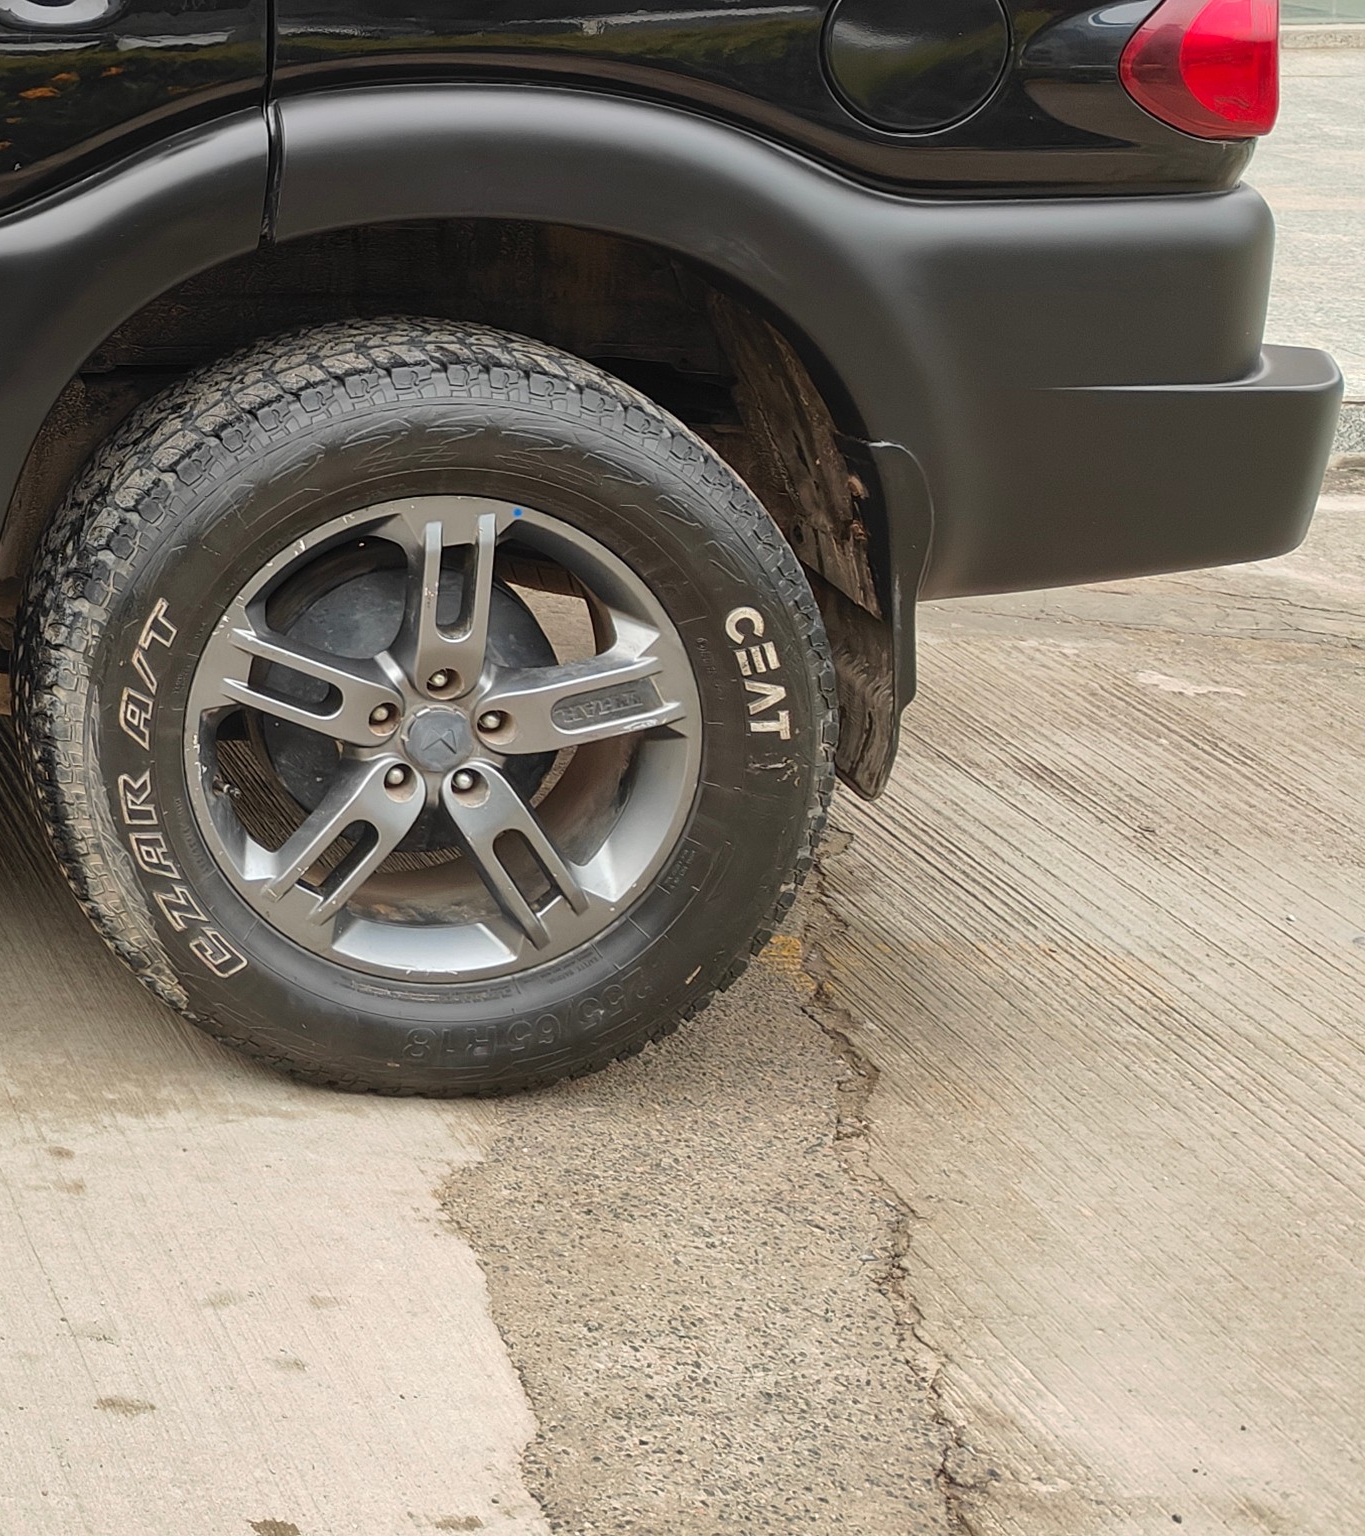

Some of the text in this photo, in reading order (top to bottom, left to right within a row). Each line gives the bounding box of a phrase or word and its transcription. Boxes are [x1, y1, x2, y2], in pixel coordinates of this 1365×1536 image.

[118, 596, 249, 979] CZAR A/T
[725, 606, 792, 741] CEAT
